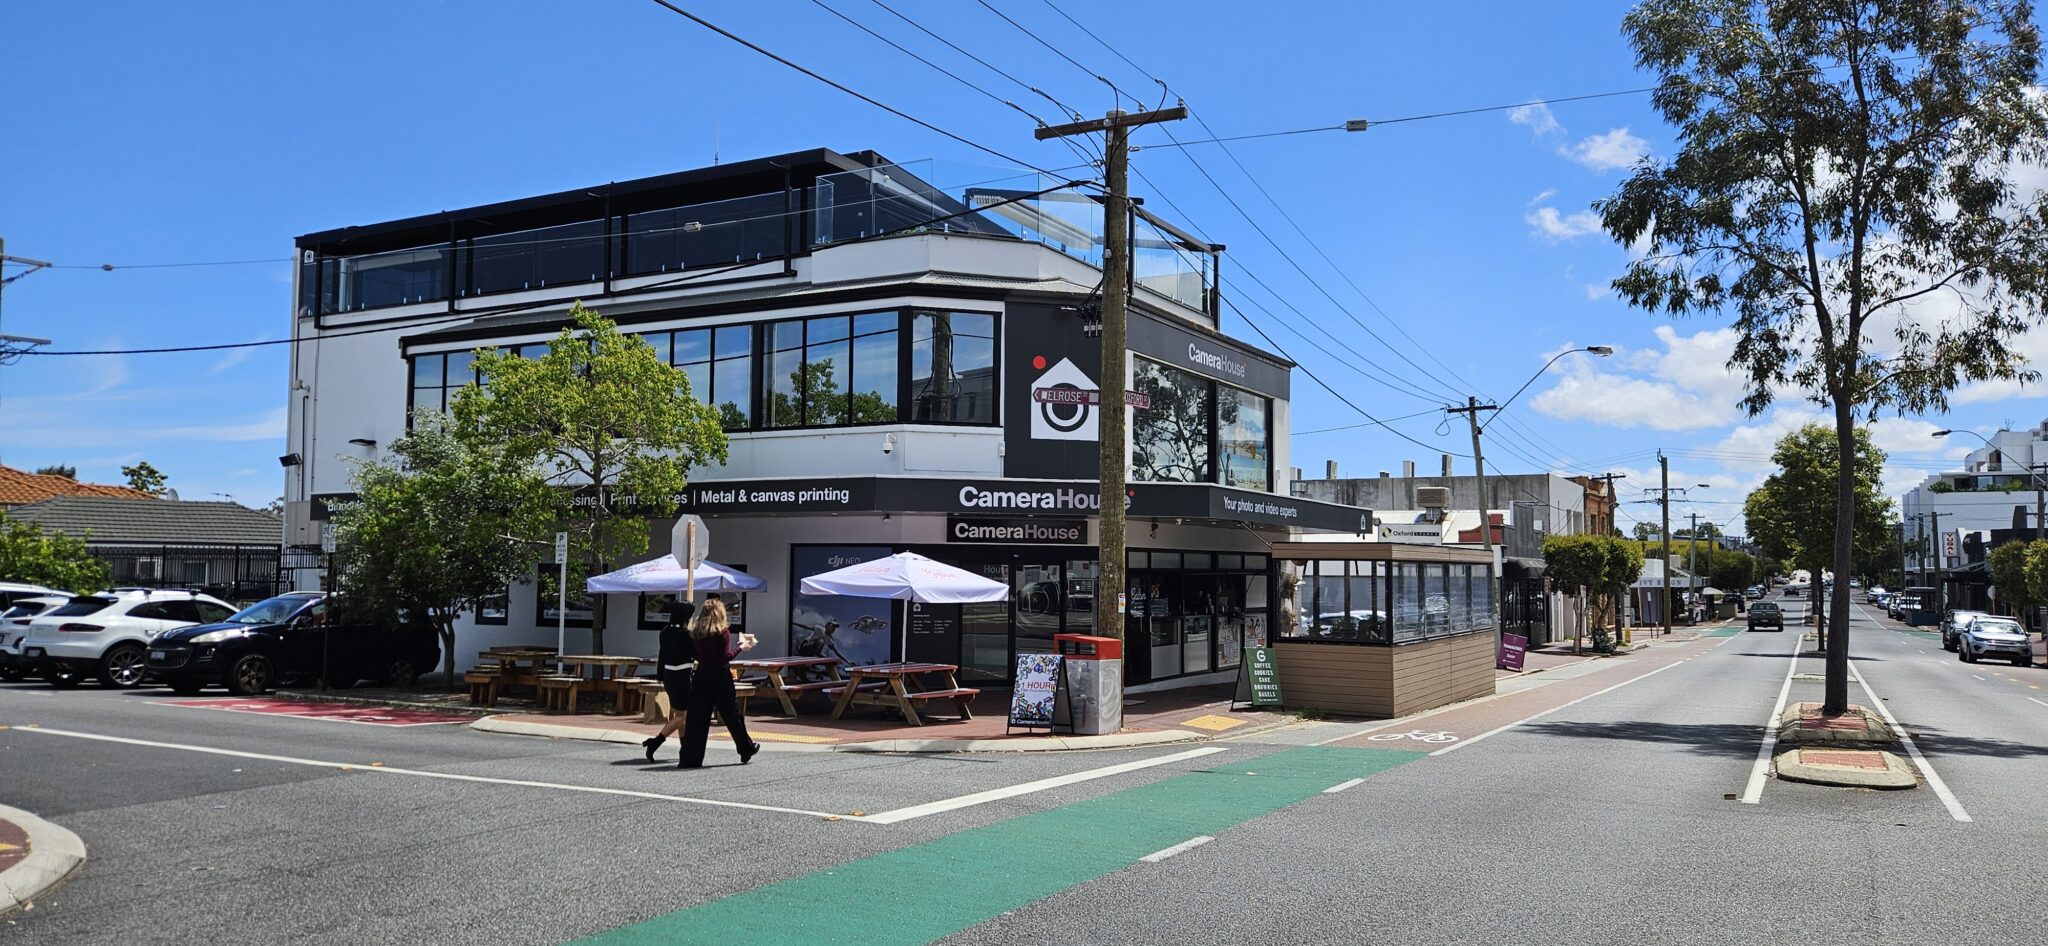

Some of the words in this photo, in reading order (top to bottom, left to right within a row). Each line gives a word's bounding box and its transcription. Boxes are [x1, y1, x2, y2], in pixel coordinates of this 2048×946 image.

[1188, 342, 1246, 378] CameraHouse
[1041, 390, 1082, 402] ELROSE
[610, 493, 637, 506] Pint
[701, 489, 735, 503] Metal
[738, 489, 748, 503] &
[750, 490, 796, 503] canvas
[799, 487, 850, 505] printing
[959, 486, 1132, 510] CameraHoue
[1223, 495, 1237, 510] Your
[1237, 498, 1254, 514] photo
[1254, 501, 1265, 514] and
[1265, 502, 1280, 516] video
[1279, 506, 1298, 519] experts
[954, 522, 1079, 540] CameraHouse
[845, 557, 861, 565] NEO
